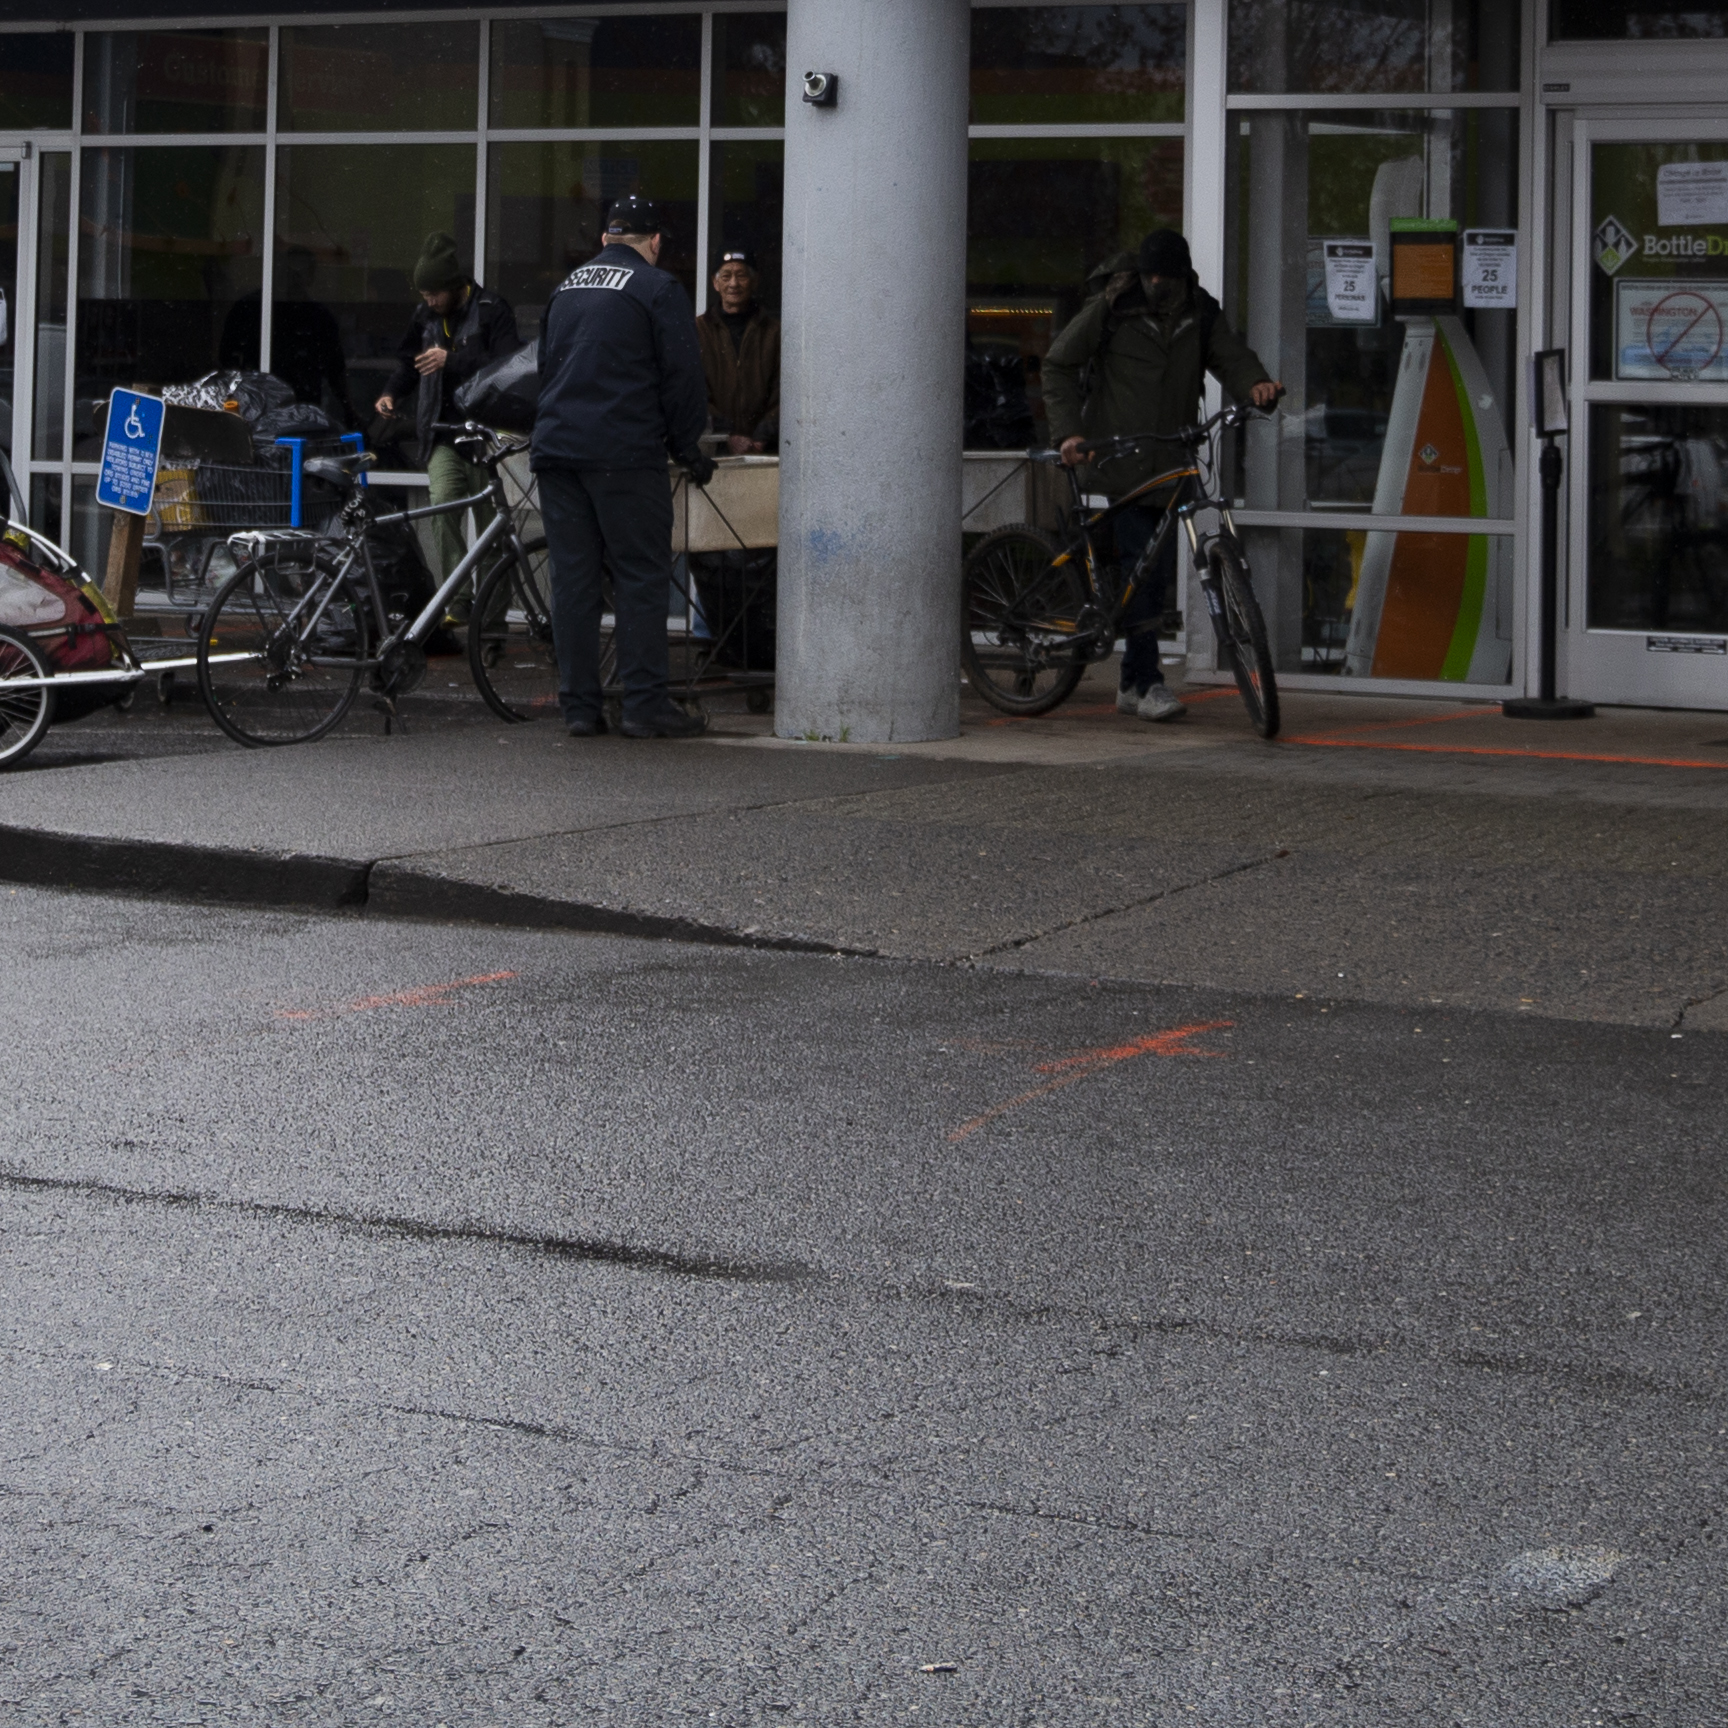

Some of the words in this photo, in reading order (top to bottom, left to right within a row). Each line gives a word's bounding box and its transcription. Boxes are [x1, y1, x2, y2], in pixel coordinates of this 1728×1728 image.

[562, 267, 632, 290] SECURITY
[1482, 269, 1498, 282] 25
[1343, 280, 1356, 292] 25
[1471, 285, 1508, 294] PEOPLE
